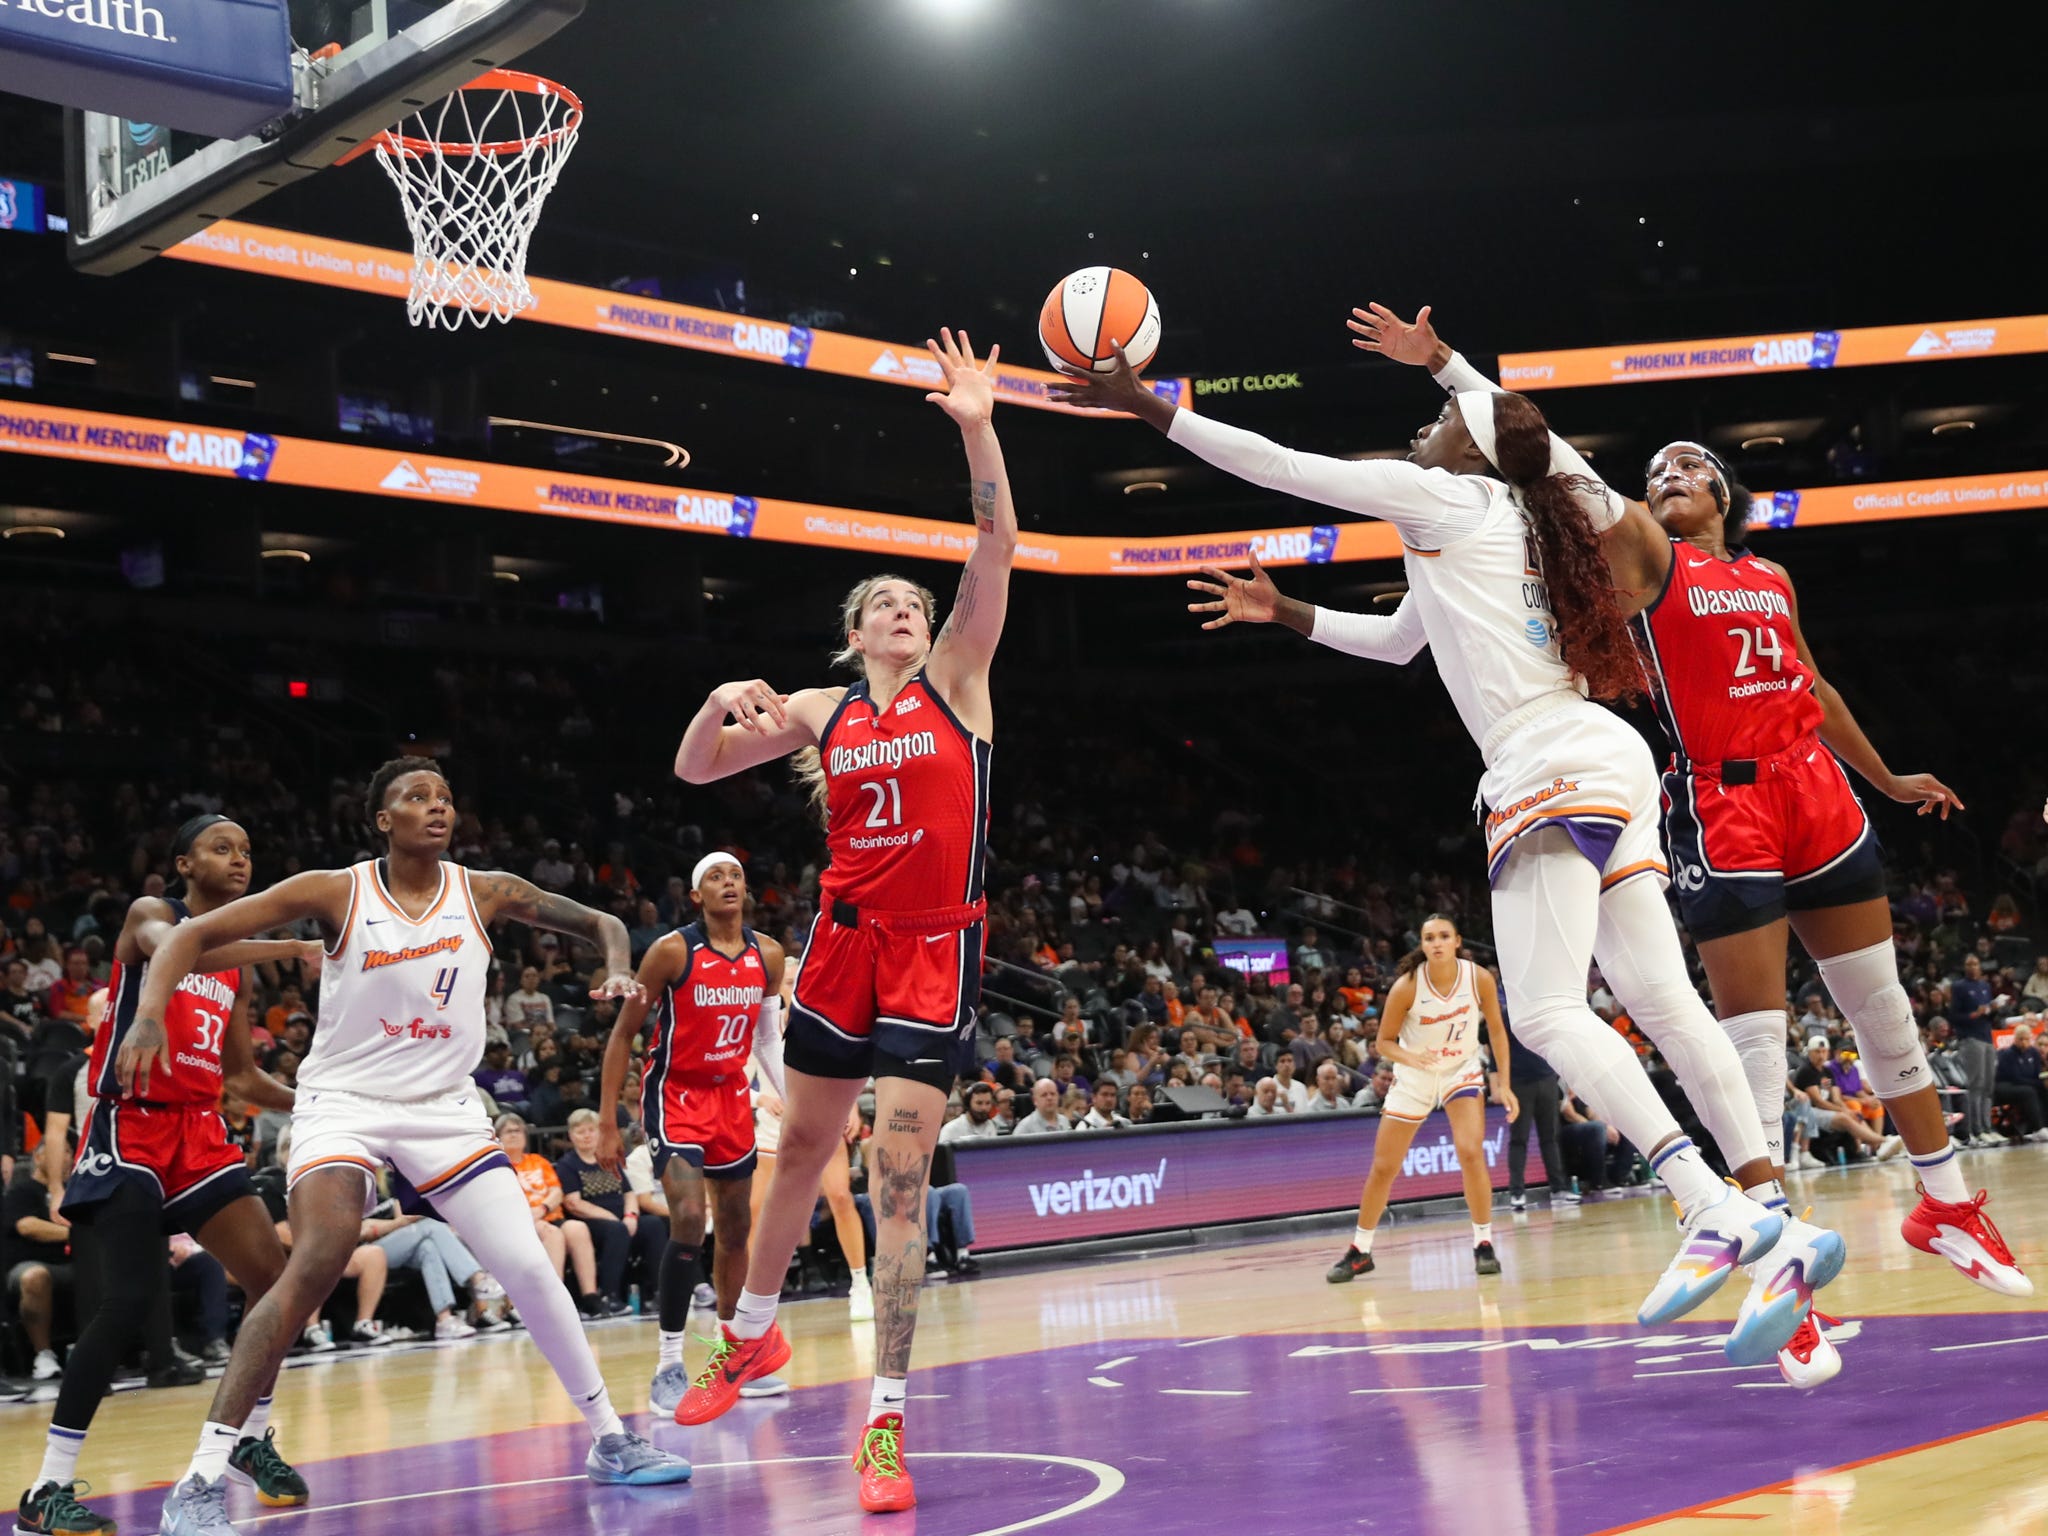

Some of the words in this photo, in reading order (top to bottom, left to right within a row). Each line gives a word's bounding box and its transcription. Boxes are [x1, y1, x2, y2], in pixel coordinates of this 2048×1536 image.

[0, 0, 169, 42] ealth
[245, 238, 299, 264] Credit
[303, 249, 353, 273] Union
[357, 259, 375, 277] of
[377, 264, 405, 283] the
[609, 304, 670, 331] PHOENIX
[732, 321, 789, 358] CARD
[1623, 355, 1685, 371] PHOENIX
[1690, 347, 1755, 365] MERCURY
[1752, 339, 1813, 366] CARD
[1195, 377, 1240, 395] SHOT
[0, 415, 79, 443] PHOENIX
[86, 427, 169, 454] MERCURY
[167, 430, 243, 470] CARD
[550, 484, 611, 507] PHOENIX
[616, 492, 678, 515] MERCURY
[675, 494, 734, 528] CARD
[1854, 491, 1904, 510] Official
[1907, 490, 1950, 506] Credit
[1954, 487, 1997, 502] Union
[1999, 484, 2014, 498] of
[2016, 482, 2041, 497] the
[804, 516, 849, 537] Official
[851, 522, 890, 542] Credit
[892, 529, 928, 546] Union
[930, 531, 943, 547] of
[944, 533, 970, 549] the
[1121, 547, 1182, 563] PHOENIX
[1187, 541, 1251, 560] MERCURY
[1250, 532, 1312, 560] CARD
[1727, 626, 1783, 678] 24
[895, 695, 917, 709] CAR
[1728, 677, 1787, 699] Robinhood
[896, 701, 922, 716] max
[830, 731, 937, 777] Washington
[860, 778, 902, 828] 21
[850, 832, 909, 849] Robinhood
[361, 934, 465, 973] Mercury
[431, 967, 459, 1011] 4
[192, 1008, 224, 1056] 32
[715, 1014, 748, 1048] 20
[1446, 1020, 1468, 1043] 12
[888, 1122, 922, 1133] Matter
[894, 1108, 919, 1119] Mind
[1402, 1136, 1496, 1176] verizn
[1028, 1168, 1155, 1216] verizon
